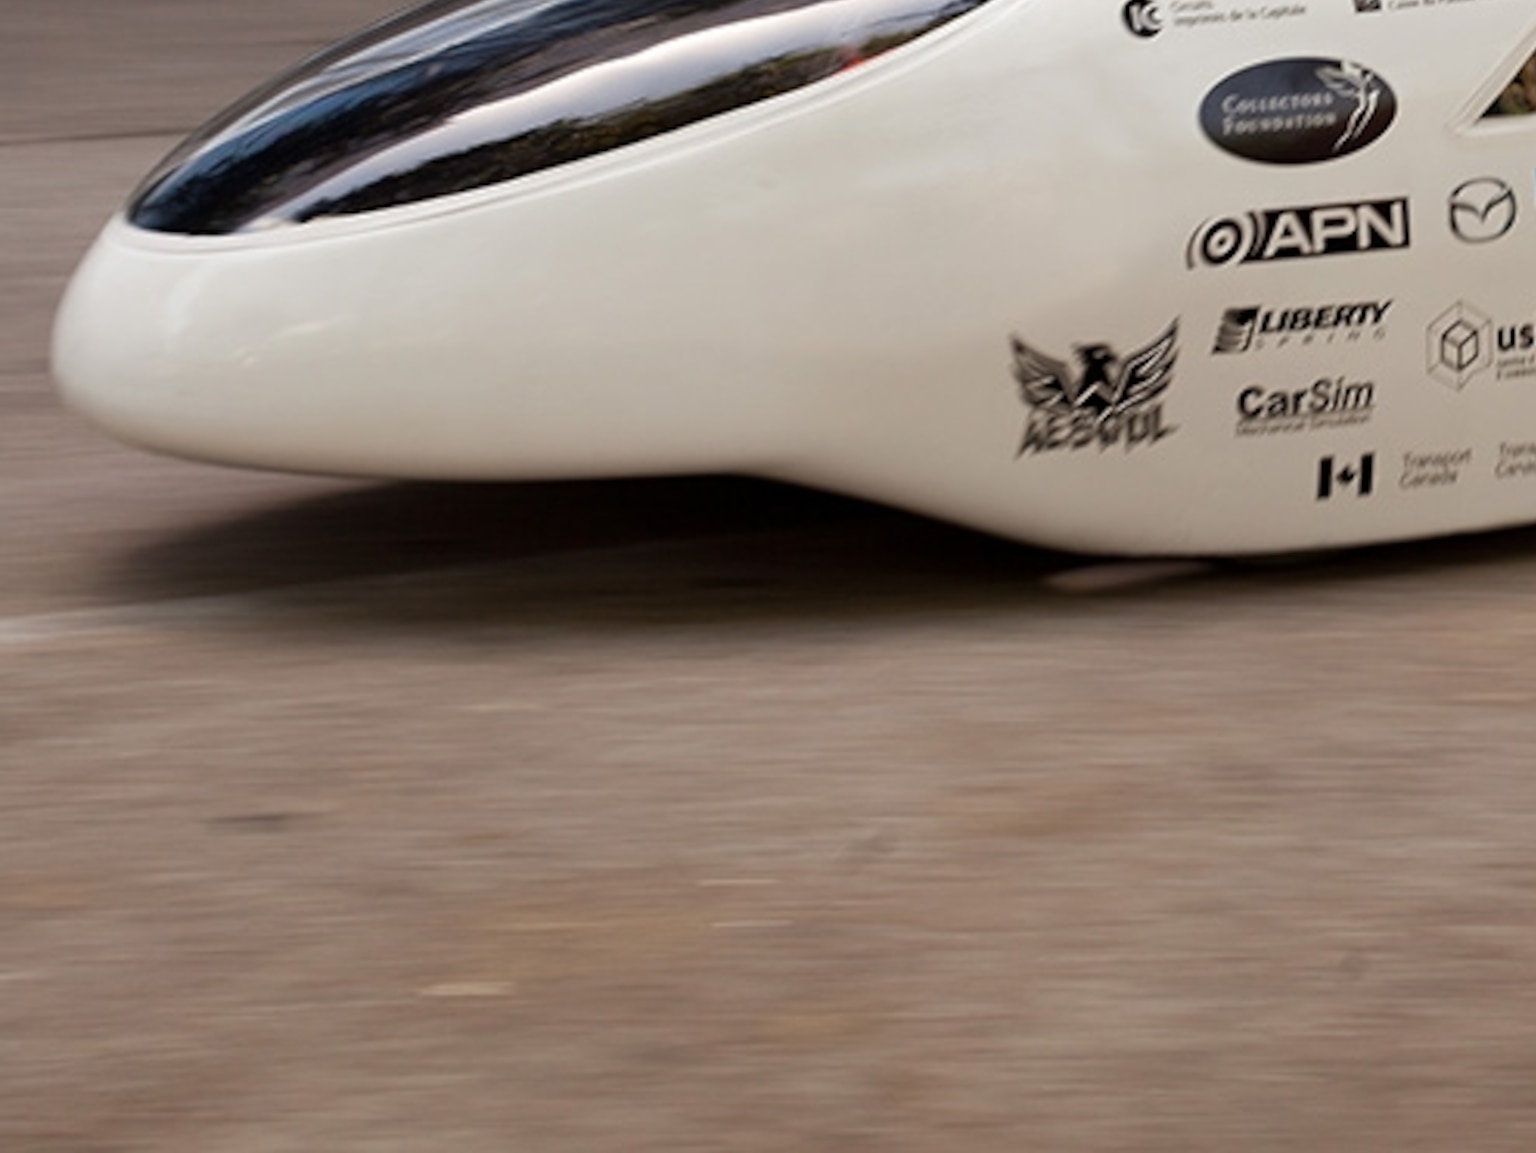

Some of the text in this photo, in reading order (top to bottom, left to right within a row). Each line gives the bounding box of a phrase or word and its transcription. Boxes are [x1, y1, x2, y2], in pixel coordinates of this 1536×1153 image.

[1262, 201, 1406, 260] APN
[1260, 299, 1393, 333] LIBERTY
[1238, 376, 1374, 419] CarSim
[1403, 448, 1472, 467] Transport
[1400, 470, 1458, 489] Canada
